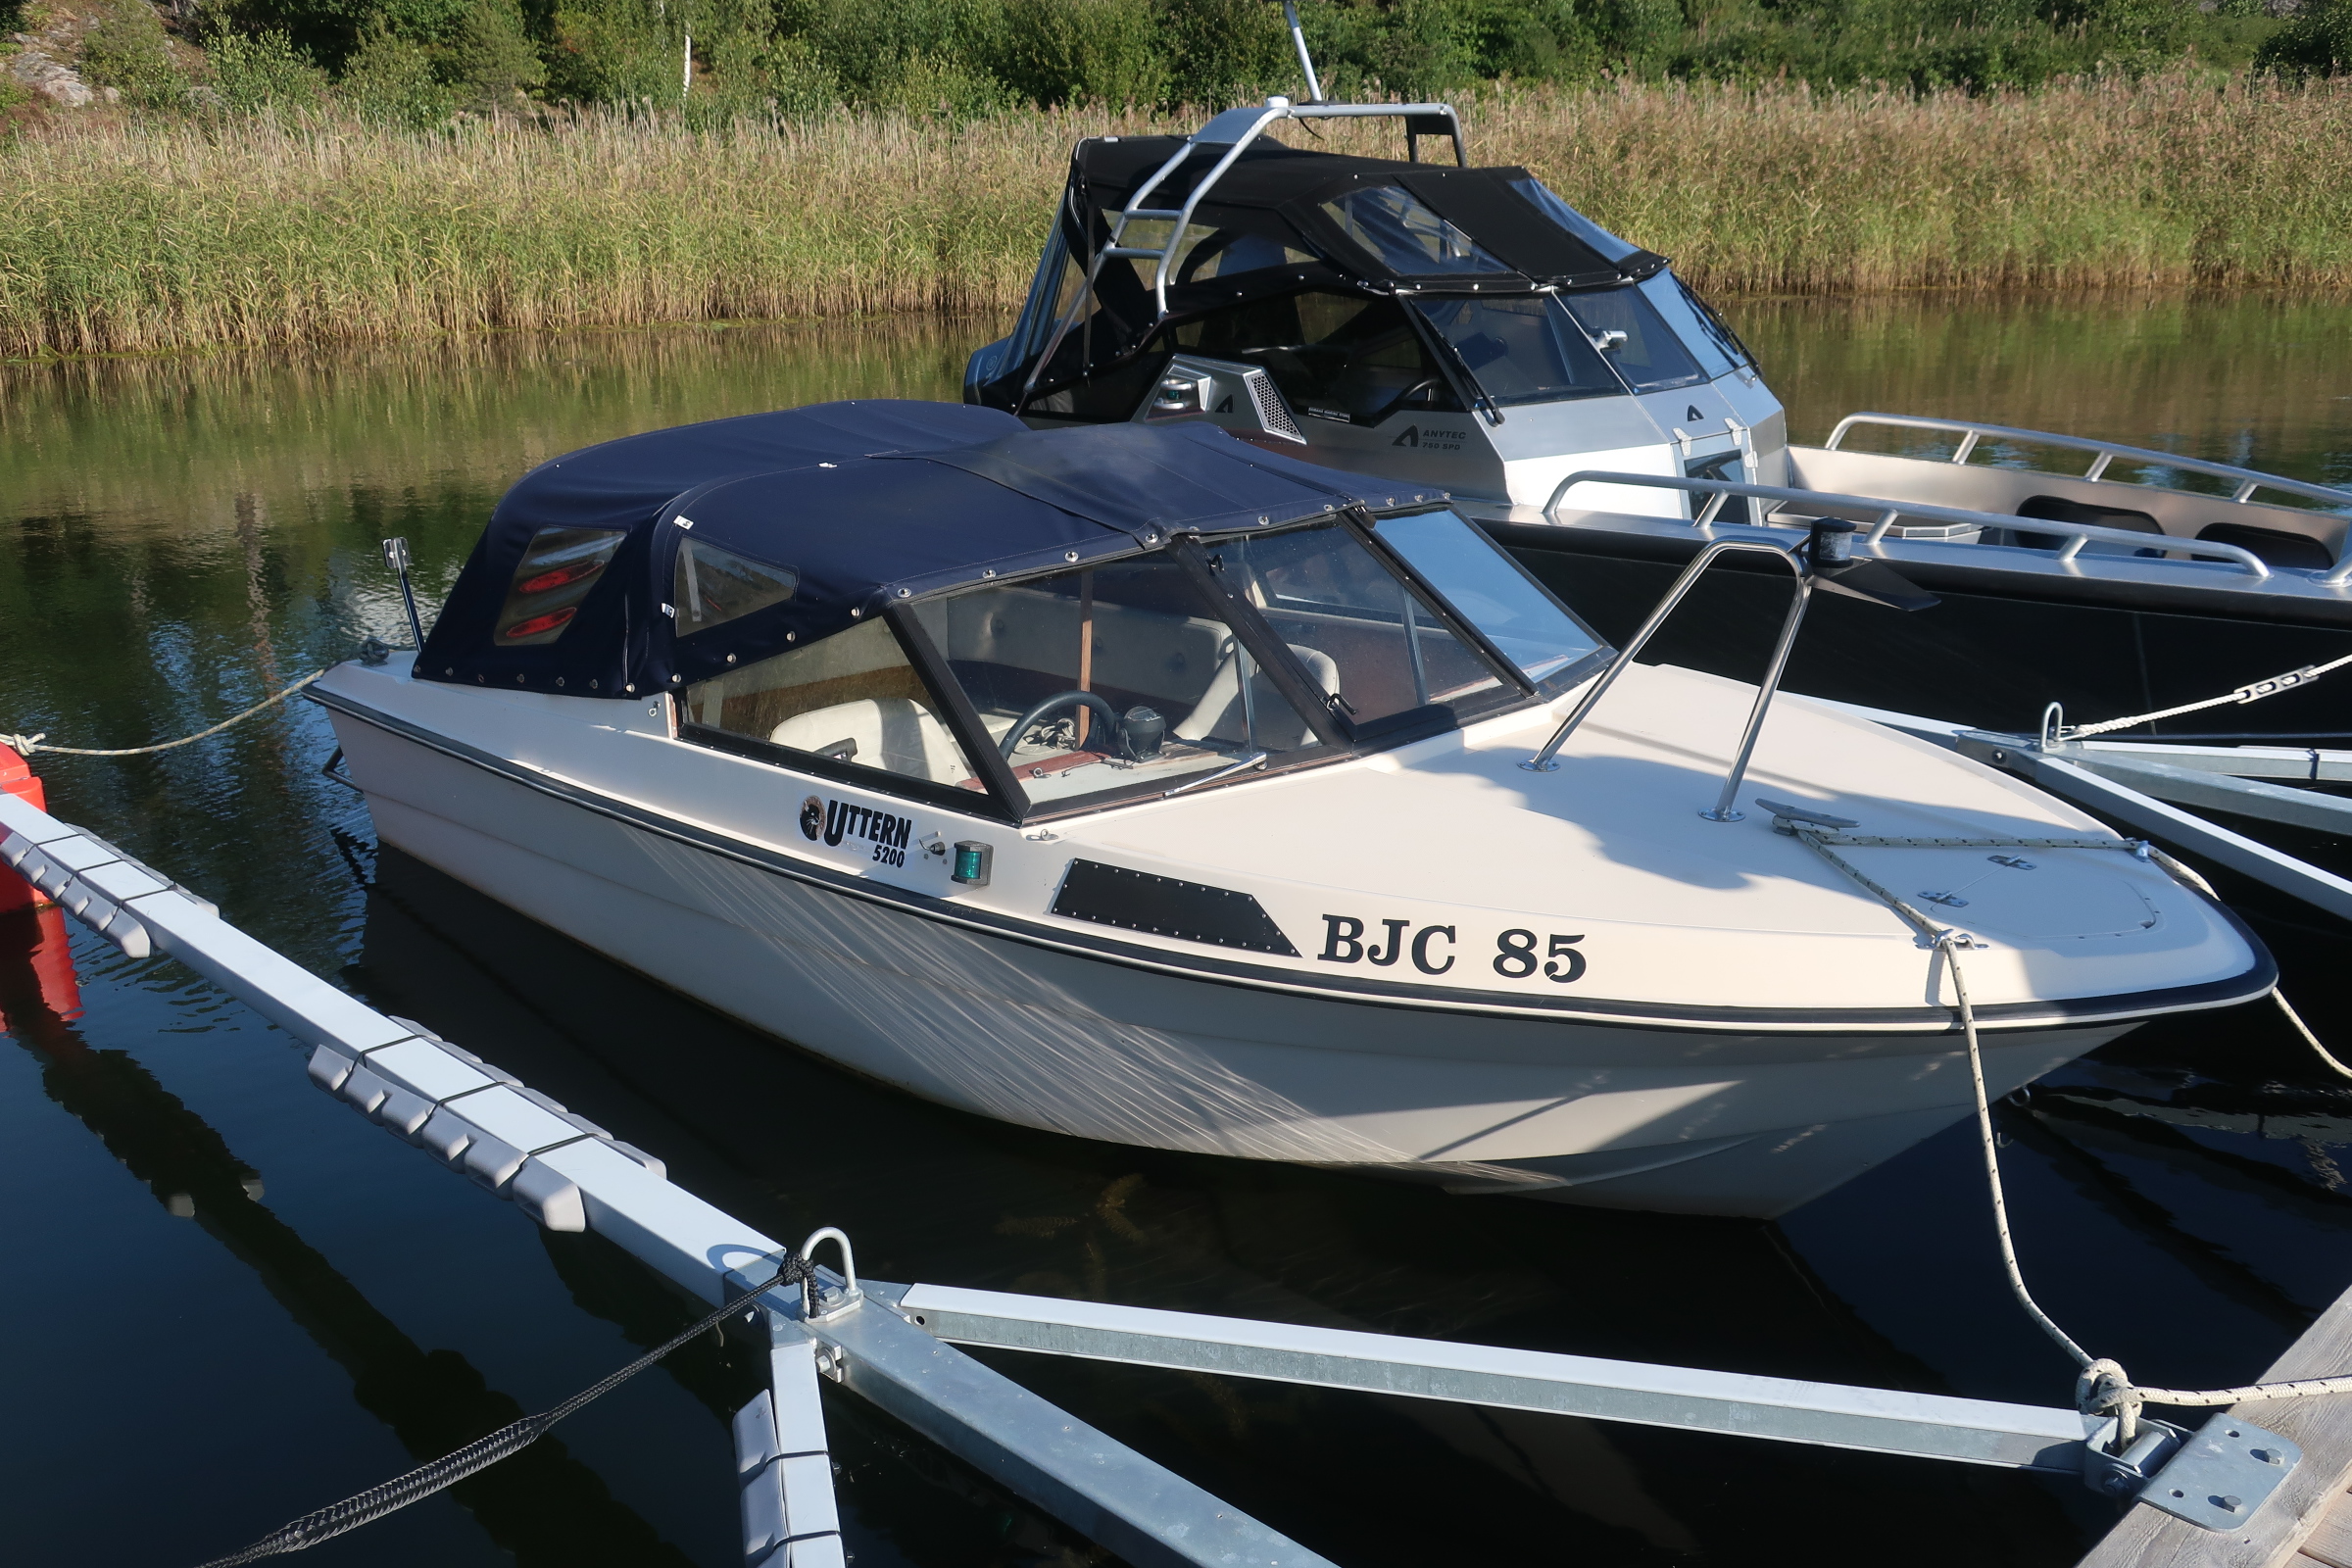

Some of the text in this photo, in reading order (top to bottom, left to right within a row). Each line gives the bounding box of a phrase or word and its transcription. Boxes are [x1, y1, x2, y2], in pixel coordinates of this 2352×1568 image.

[1423, 429, 1467, 440] ANYTEC
[824, 799, 912, 850] UTTERN
[872, 844, 906, 868] 5200
[1317, 913, 1587, 983] BJC 85
